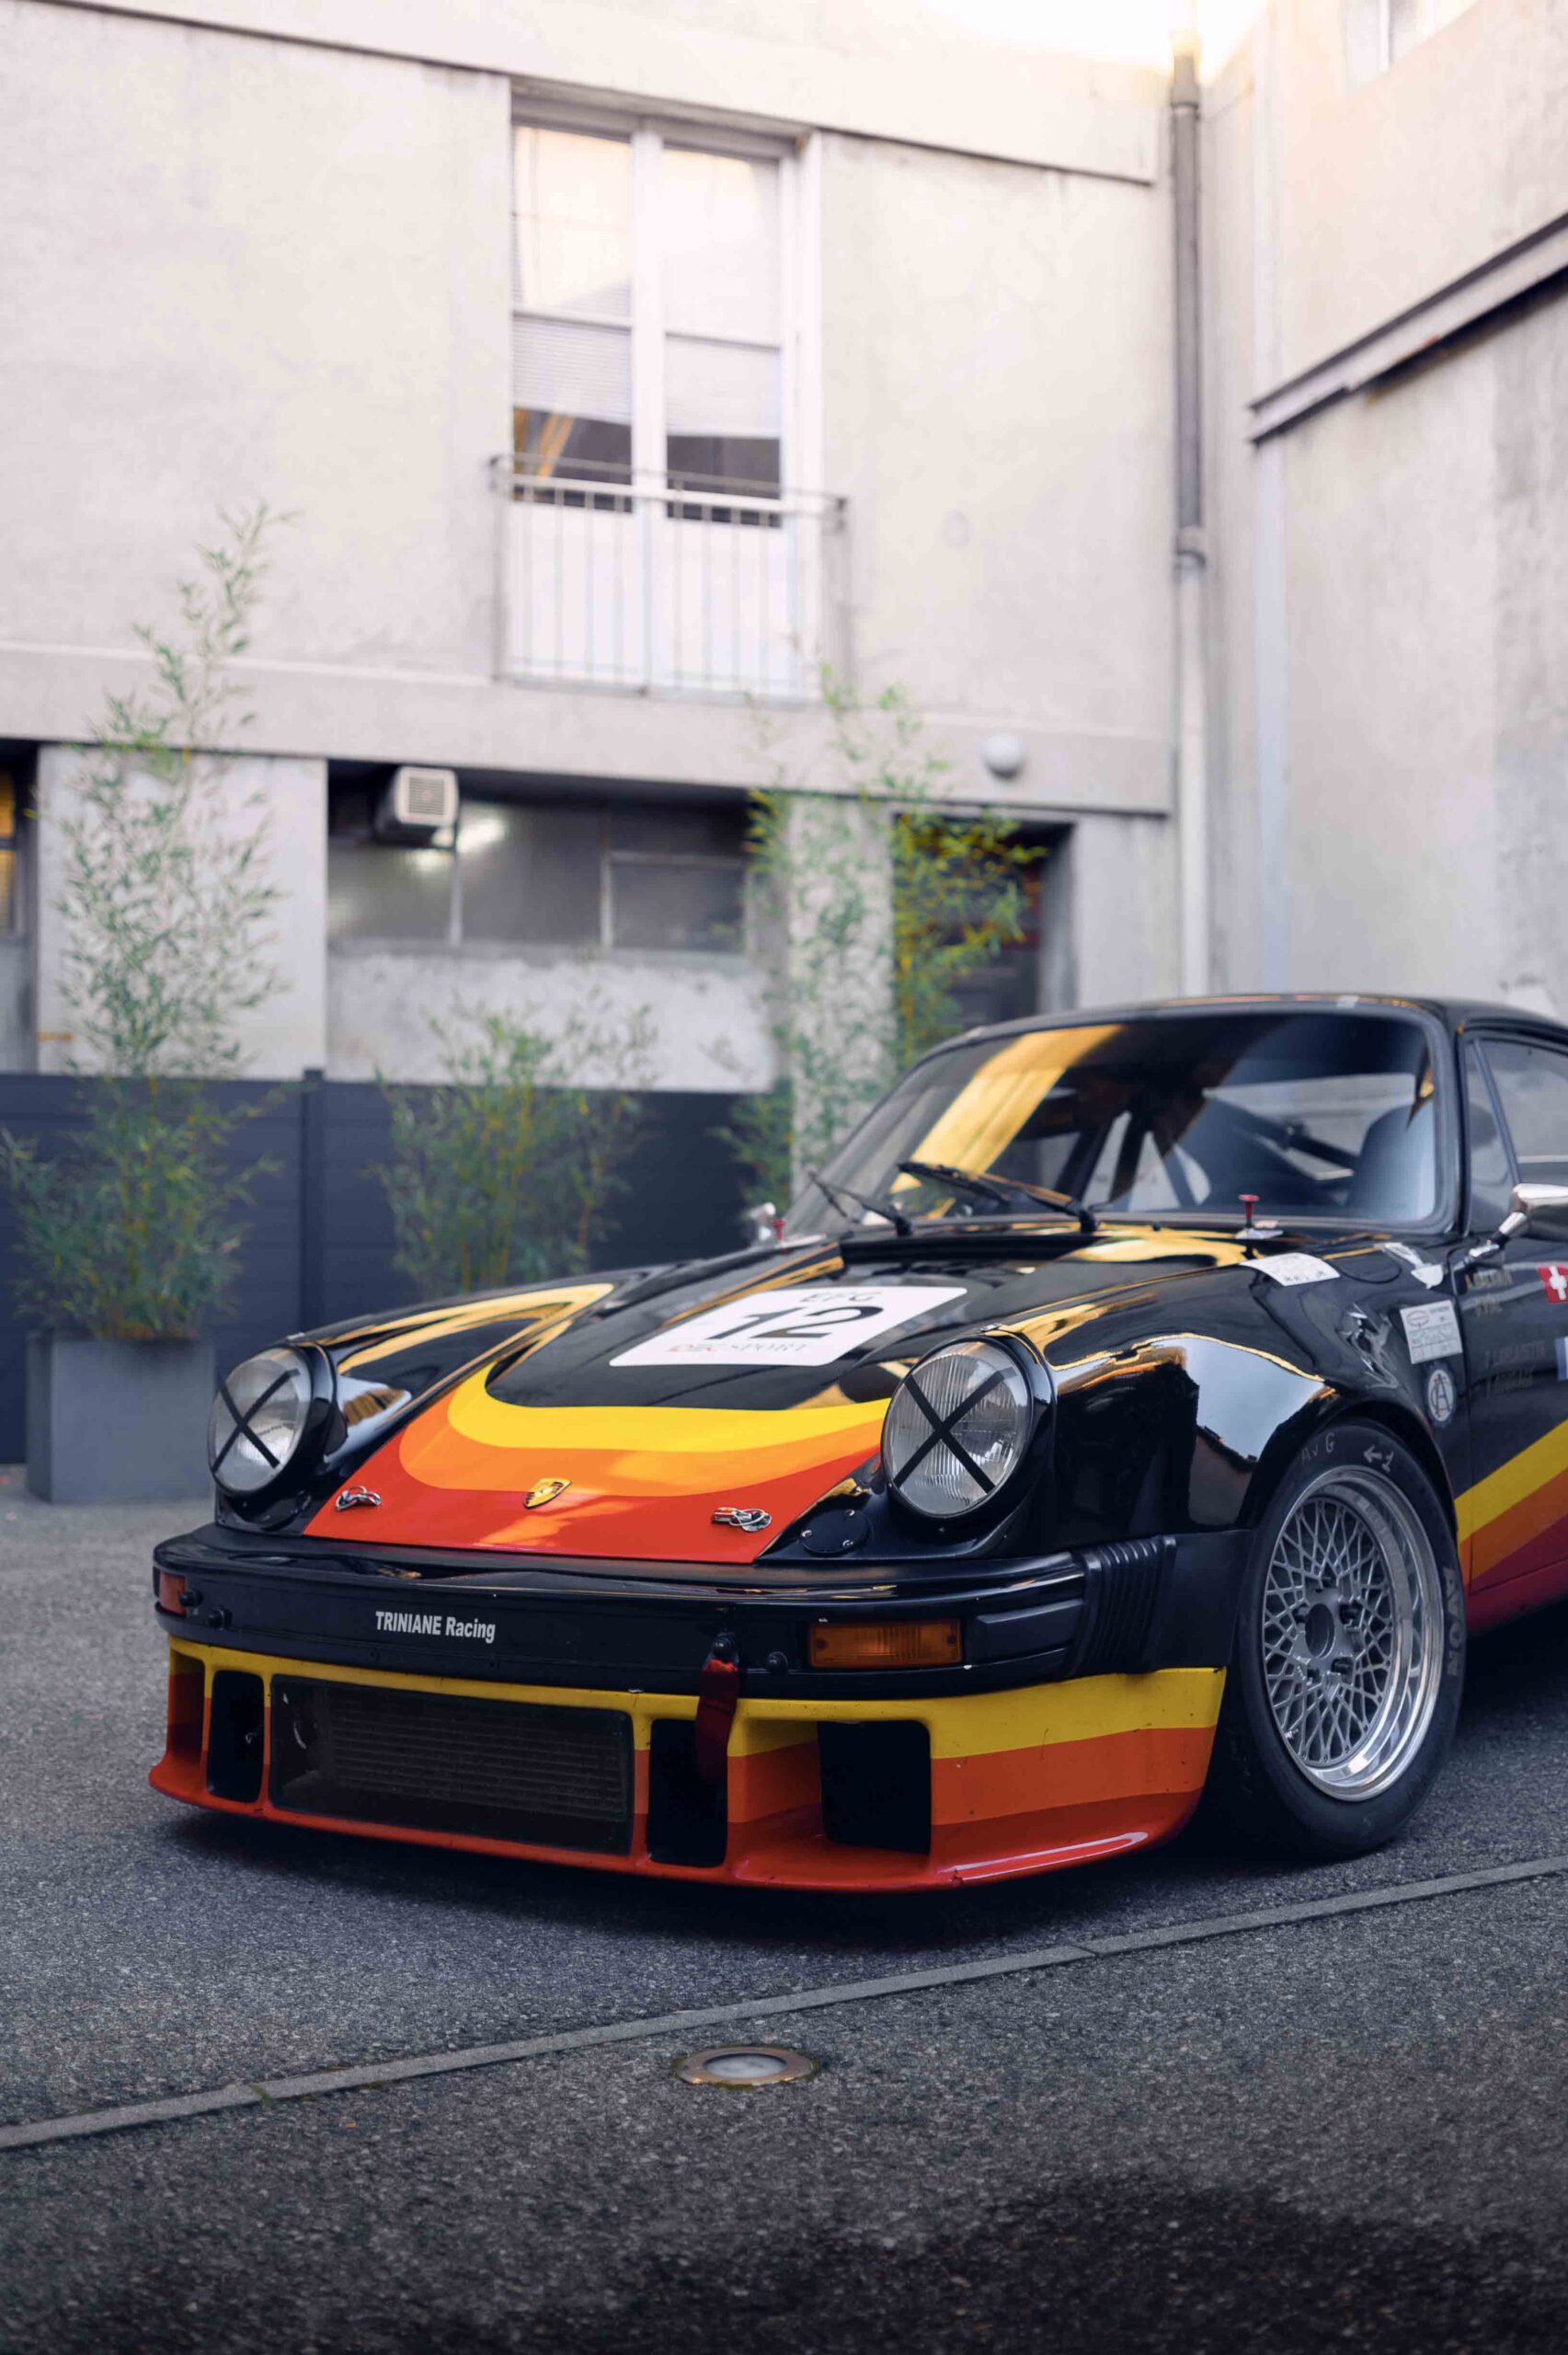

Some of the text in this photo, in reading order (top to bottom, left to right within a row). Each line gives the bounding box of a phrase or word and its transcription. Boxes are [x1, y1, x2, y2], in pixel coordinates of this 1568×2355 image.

[704, 1306, 884, 1339] 12
[375, 1611, 496, 1644] TRINIANE Racing
